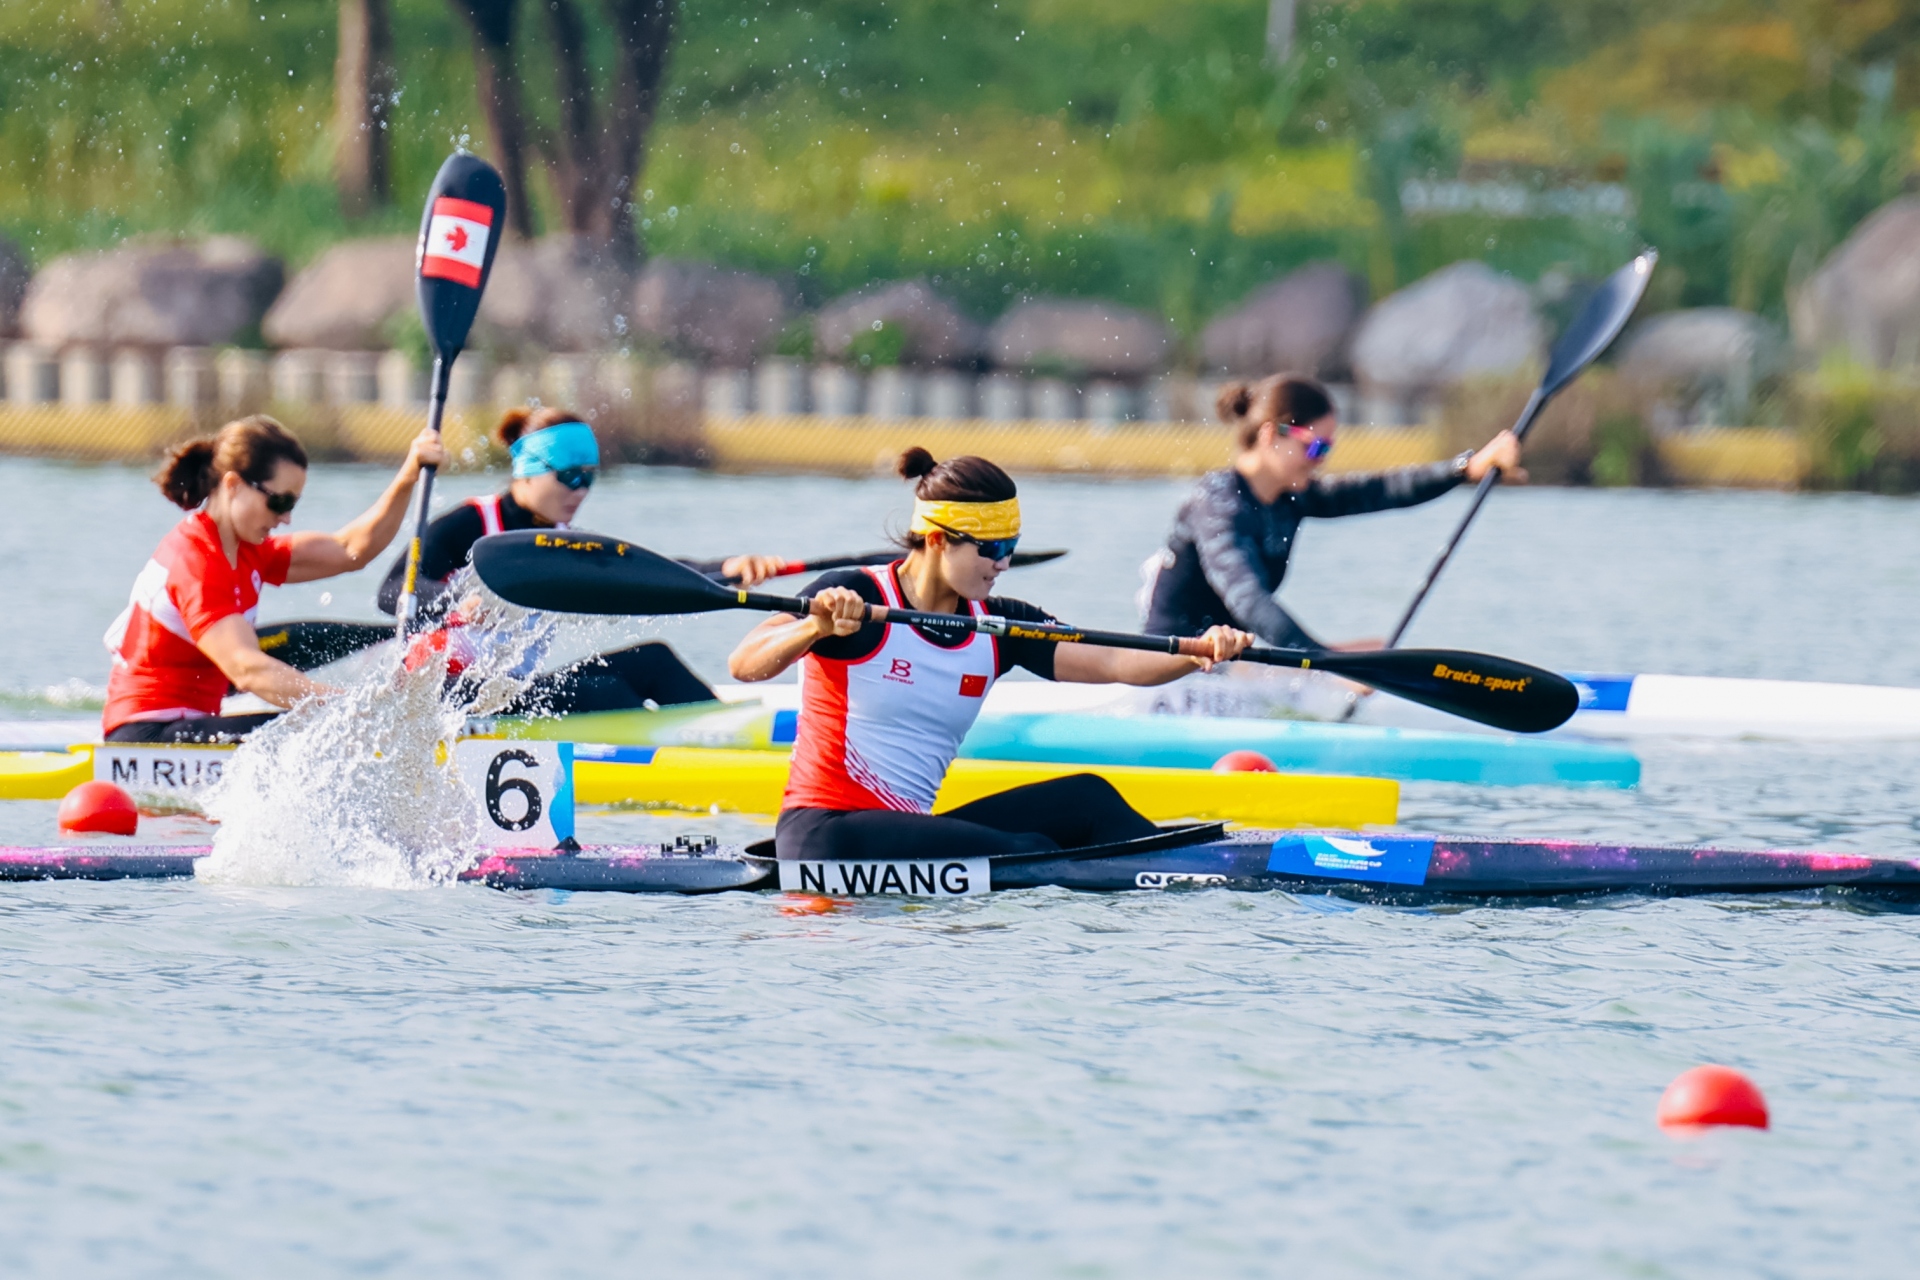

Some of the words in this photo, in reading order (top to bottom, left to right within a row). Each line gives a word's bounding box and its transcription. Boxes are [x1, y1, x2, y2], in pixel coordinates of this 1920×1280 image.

[922, 617, 944, 626] PARIS
[945, 620, 965, 628] 2024
[112, 756, 138, 783] M
[485, 747, 542, 832] 6
[800, 861, 970, 895] N.WANG
